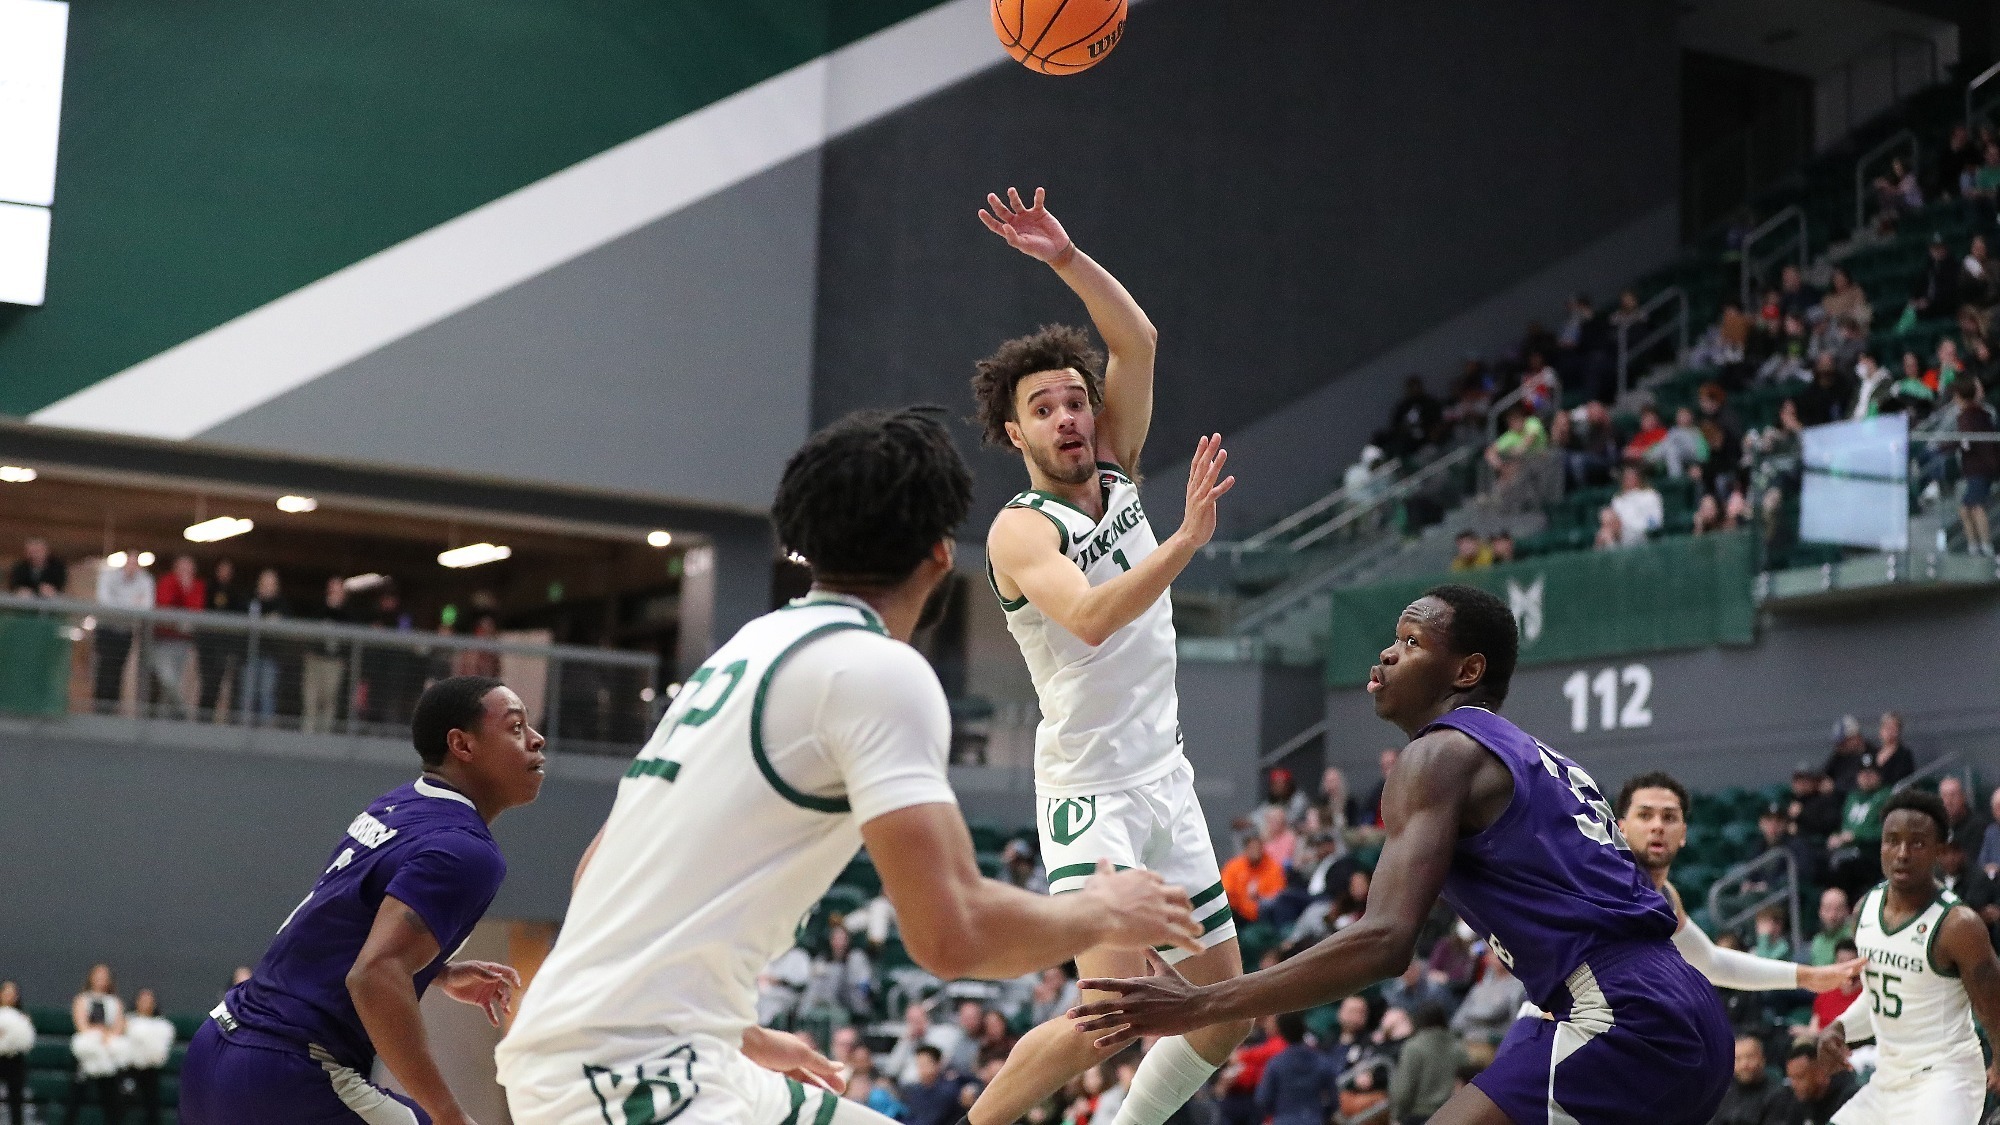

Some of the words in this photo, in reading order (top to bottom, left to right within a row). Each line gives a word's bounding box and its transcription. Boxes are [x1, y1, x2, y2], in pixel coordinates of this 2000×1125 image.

[1112, 548, 1132, 573] 1
[1562, 663, 1652, 733] 112
[1864, 968, 1903, 1018] 55
